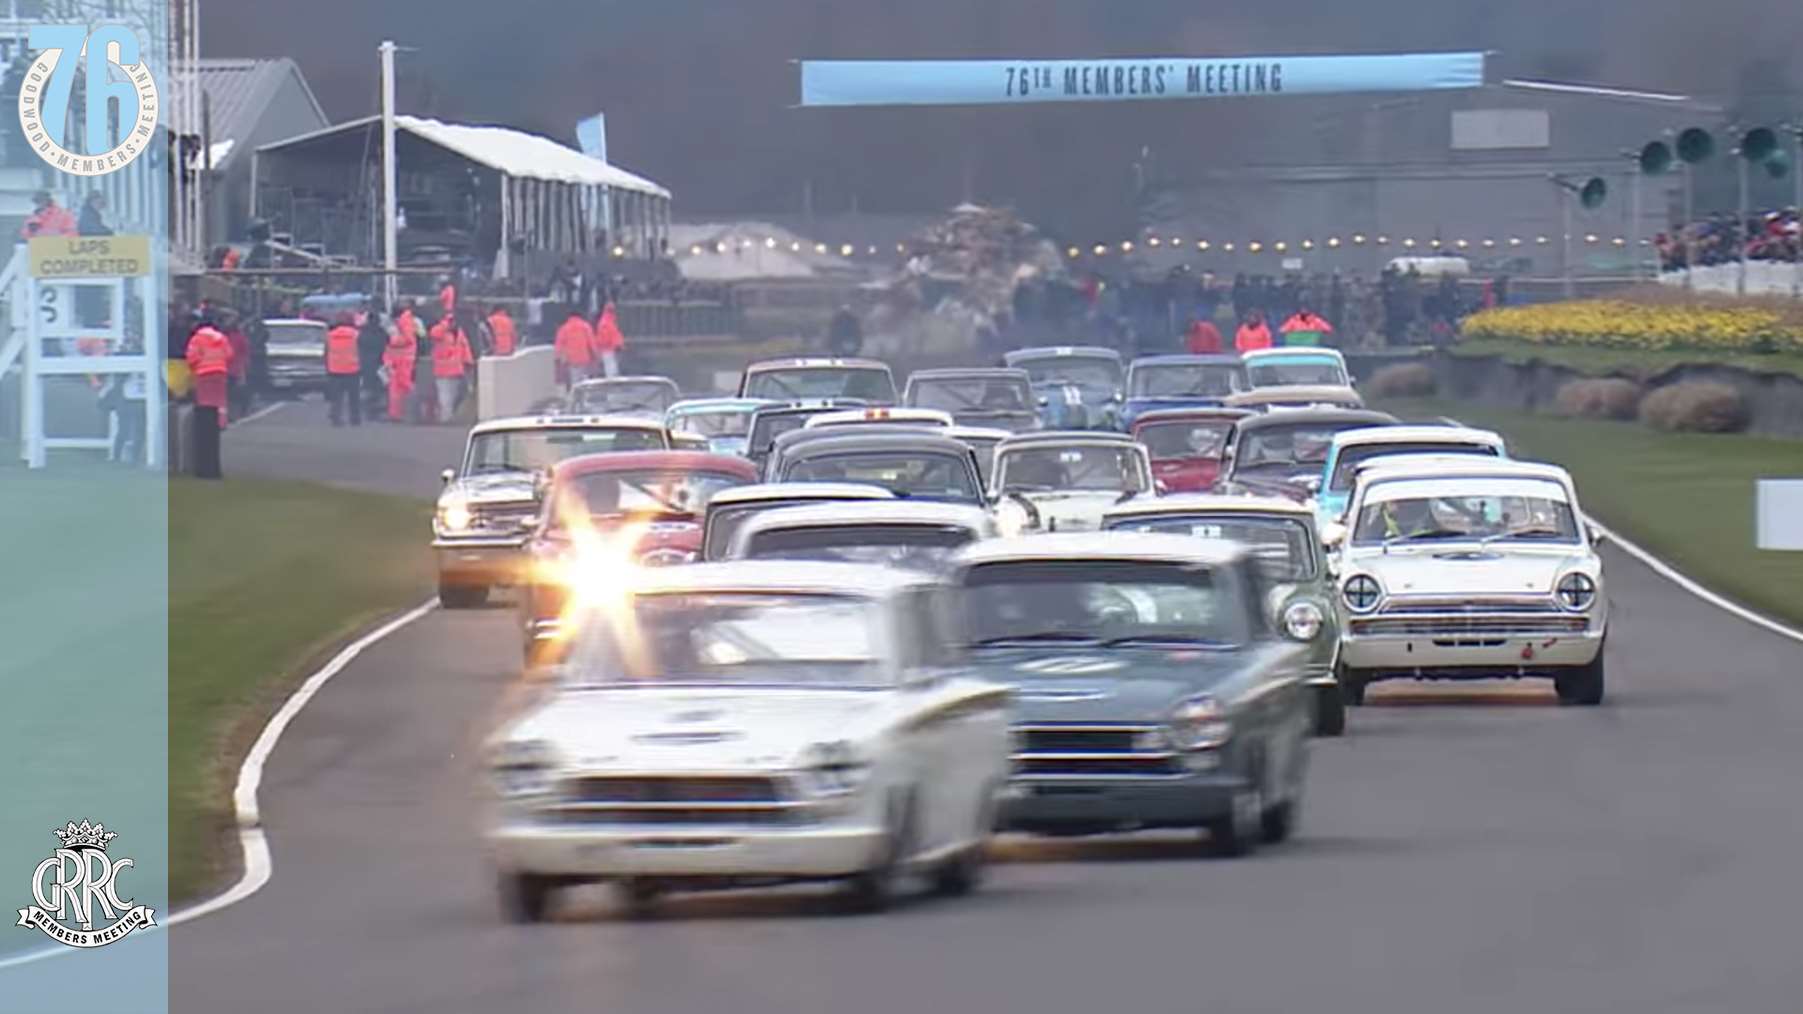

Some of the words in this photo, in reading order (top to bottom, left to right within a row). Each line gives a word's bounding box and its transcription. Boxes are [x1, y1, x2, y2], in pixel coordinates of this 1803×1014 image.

[1186, 63, 1283, 94] MEETING
[68, 239, 111, 255] LAPS
[40, 258, 139, 275] COMPLETED
